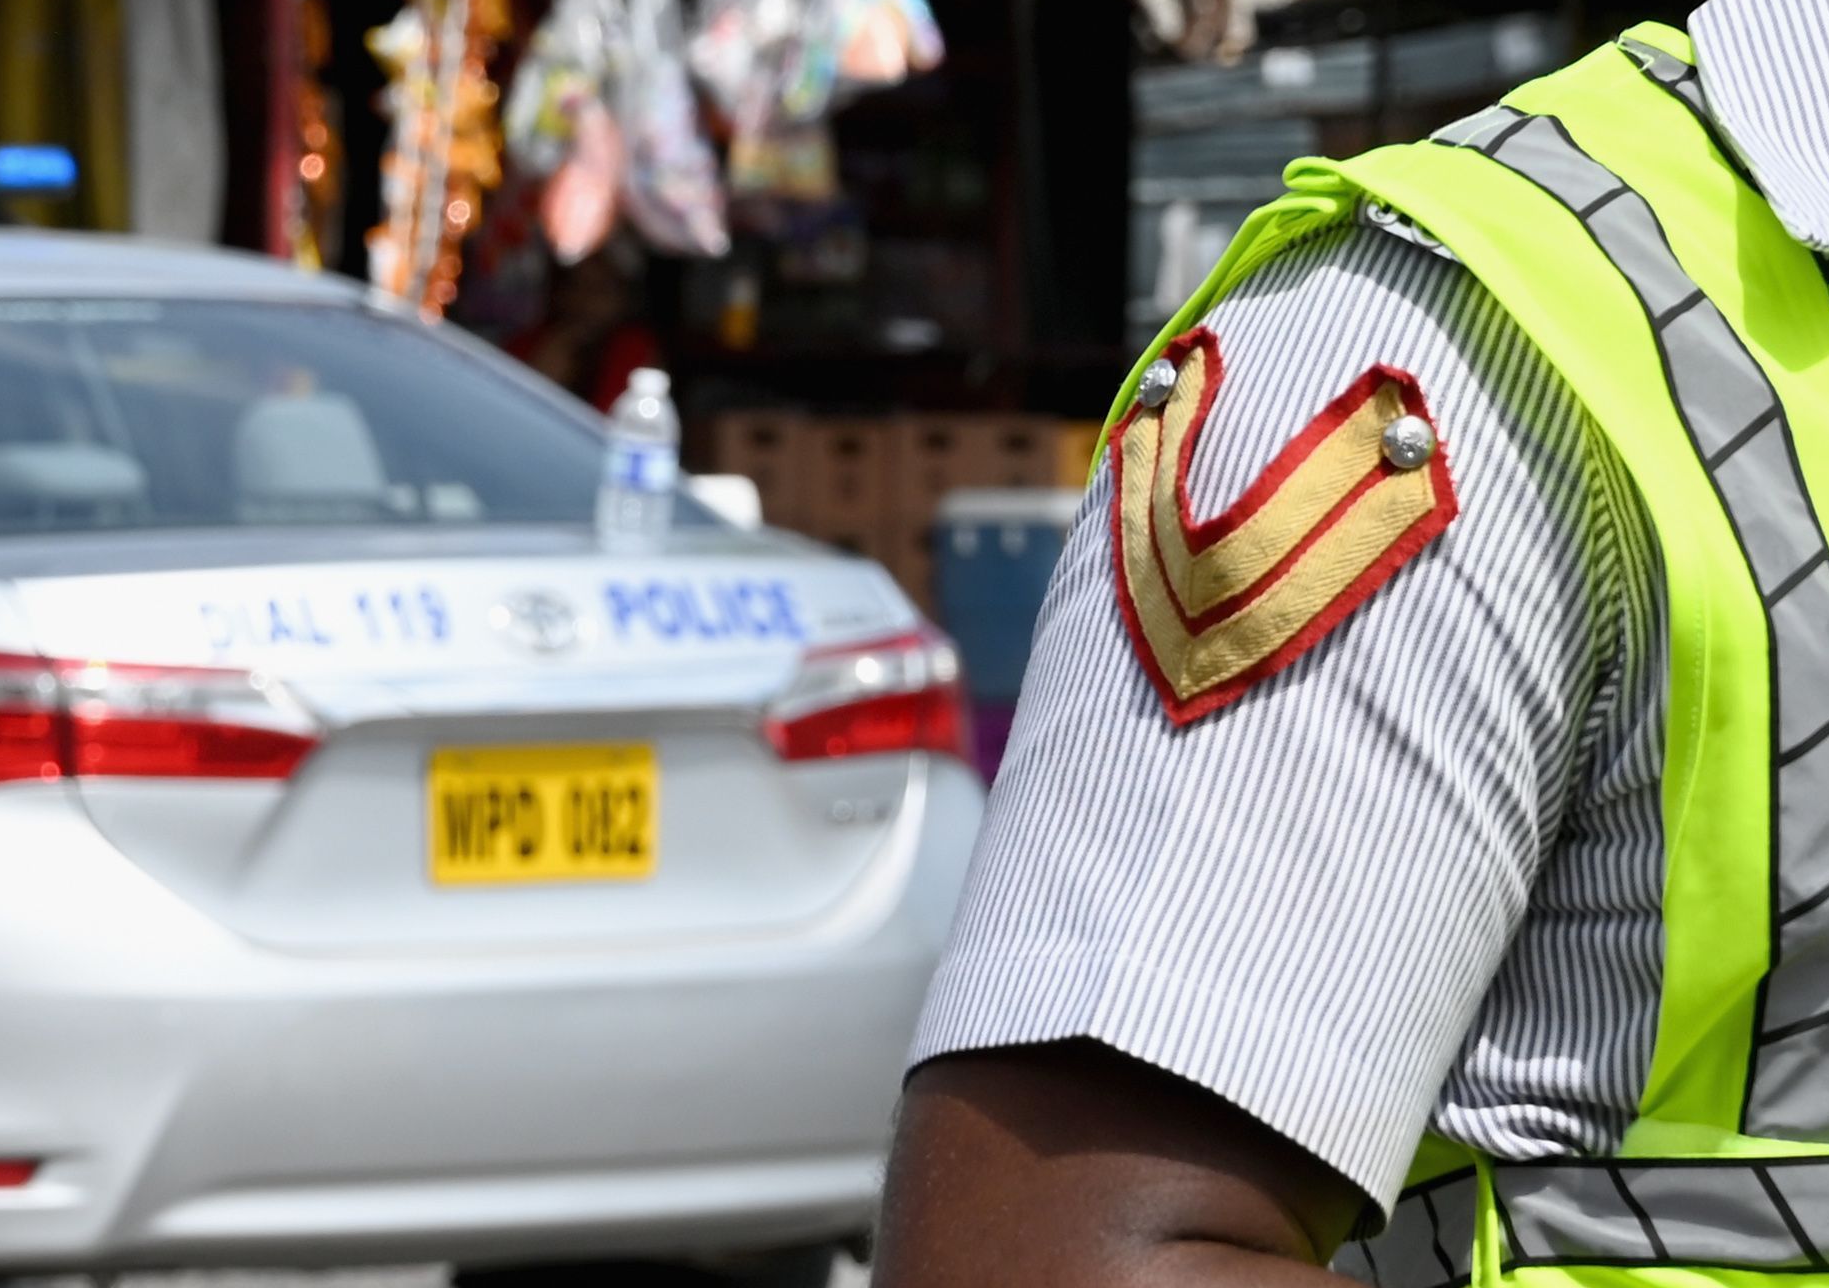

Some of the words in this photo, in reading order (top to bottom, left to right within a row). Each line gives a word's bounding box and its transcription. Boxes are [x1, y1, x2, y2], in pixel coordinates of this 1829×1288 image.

[351, 584, 452, 644] 119
[602, 577, 808, 645] POLICE
[564, 781, 650, 863] 082
